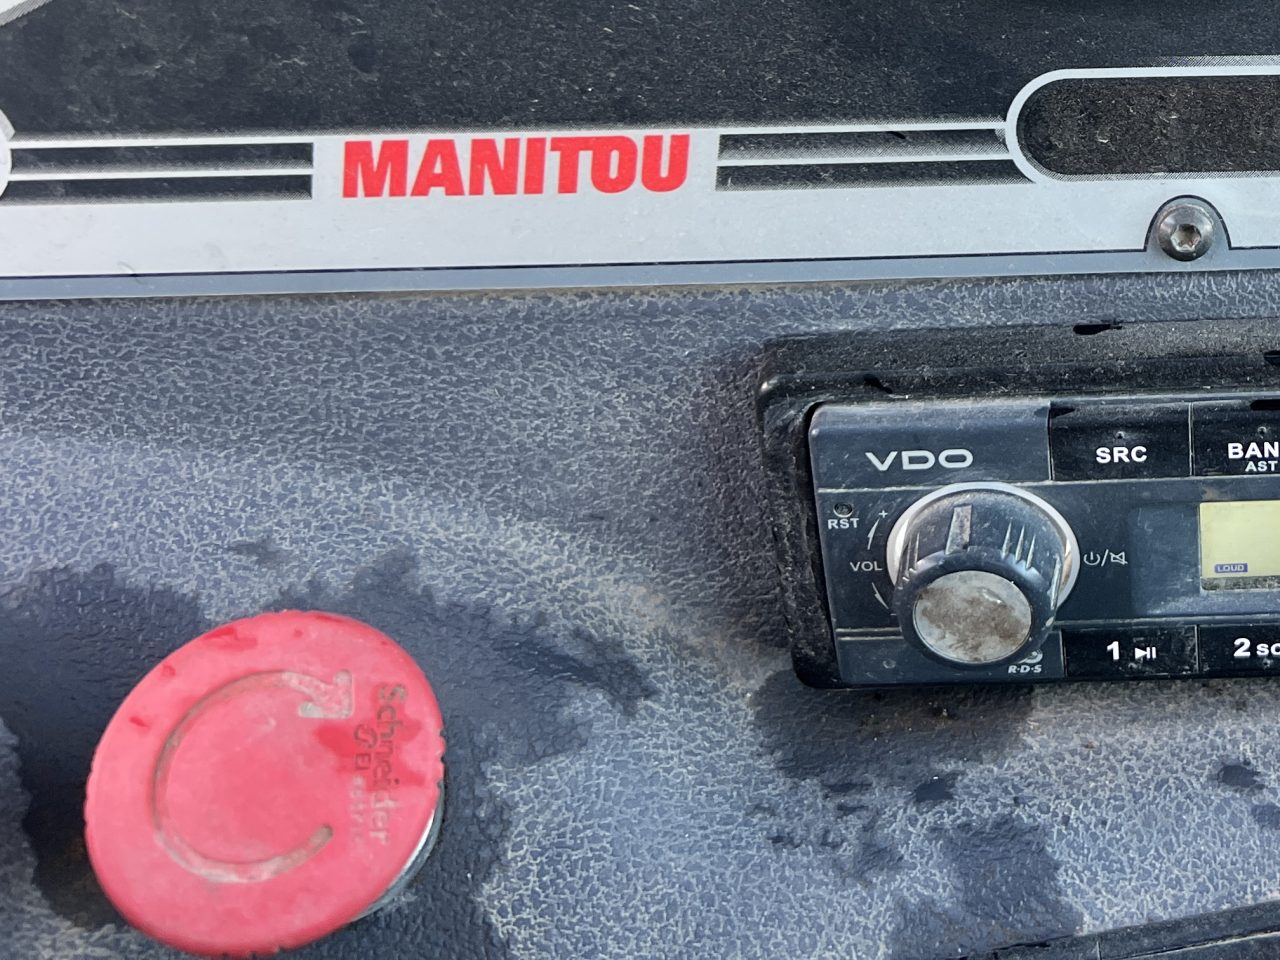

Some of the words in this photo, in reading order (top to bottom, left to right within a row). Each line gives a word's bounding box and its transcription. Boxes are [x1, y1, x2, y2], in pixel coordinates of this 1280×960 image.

[342, 134, 690, 199] MANITOU
[865, 449, 975, 472] VDO
[1095, 446, 1148, 464] SRC
[1244, 460, 1279, 472] AST
[827, 518, 859, 529] RST
[850, 561, 883, 572] VOL
[1216, 564, 1246, 573] LOUD
[1106, 641, 1120, 660] 1
[1233, 638, 1252, 657] 2
[370, 685, 406, 844] Schneider
